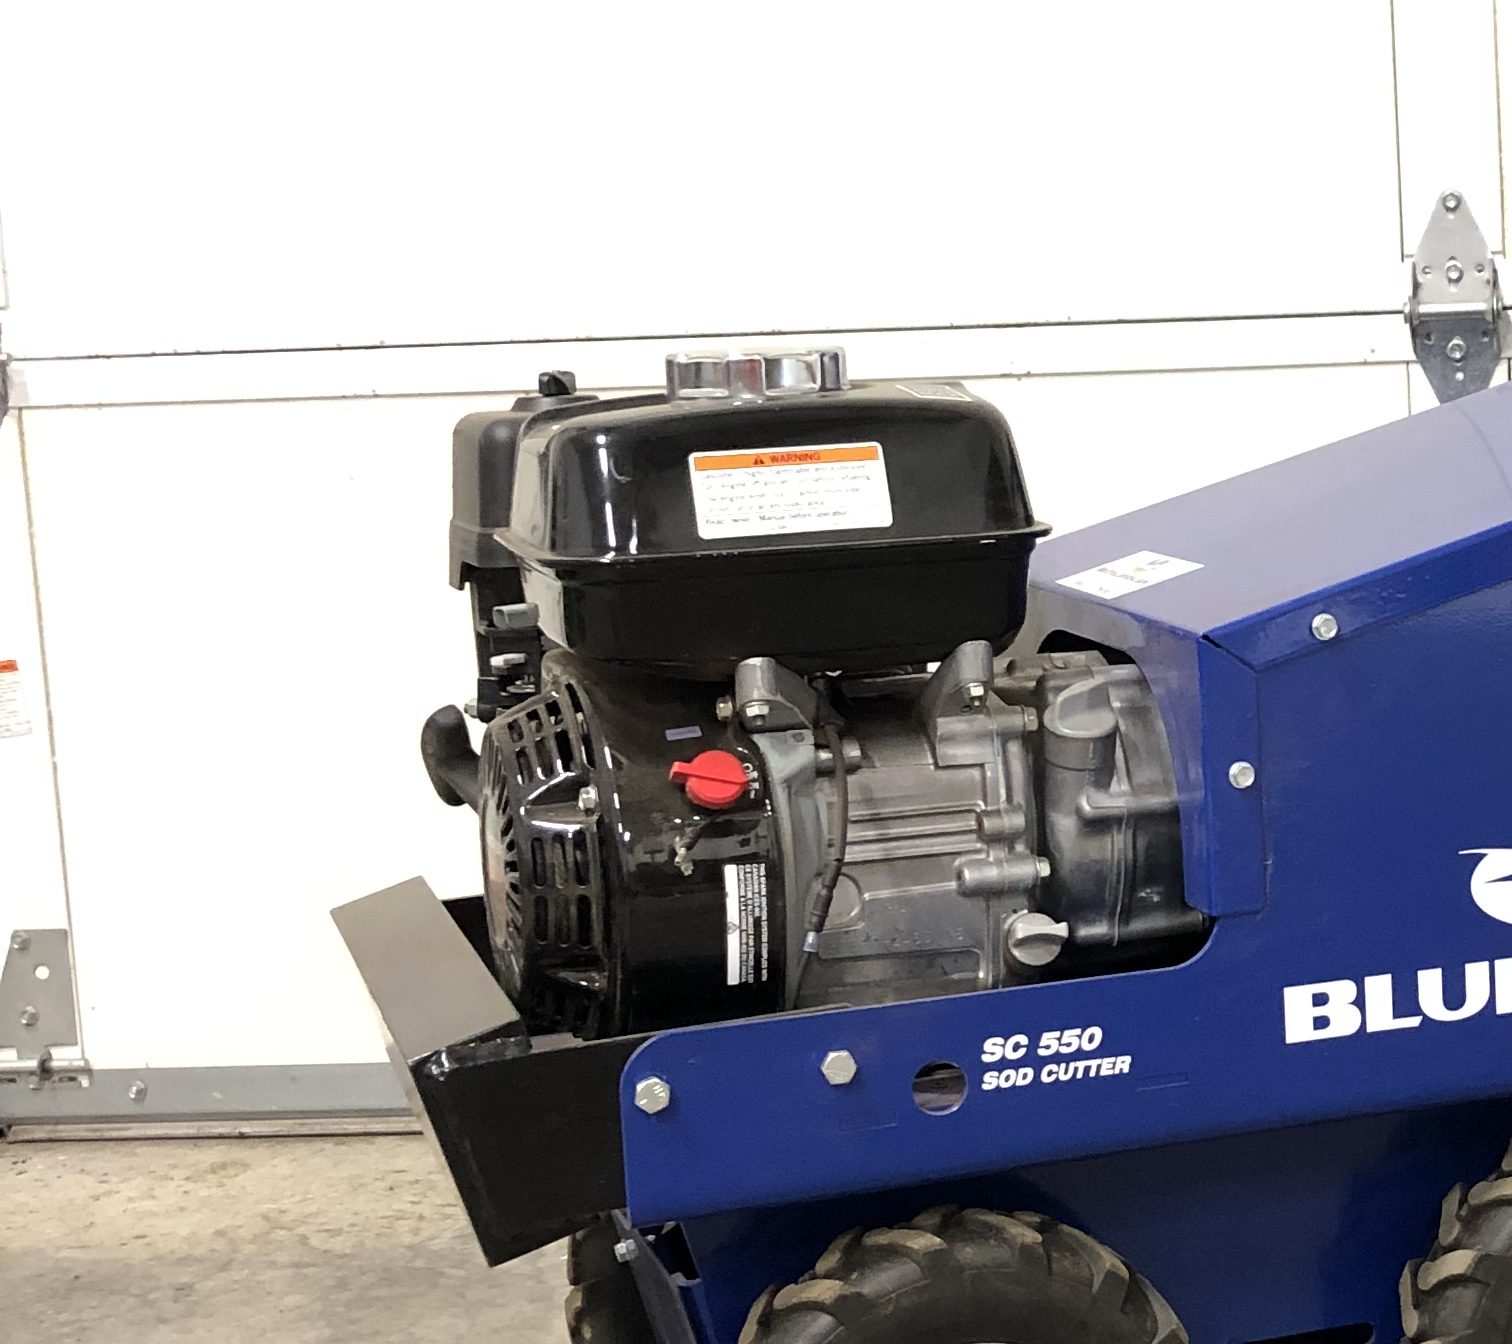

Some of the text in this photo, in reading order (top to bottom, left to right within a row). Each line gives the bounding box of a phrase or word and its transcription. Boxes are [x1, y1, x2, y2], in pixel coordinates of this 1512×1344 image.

[769, 452, 821, 464] WARNING
[981, 1026, 1103, 1063] SC 550
[981, 1055, 1132, 1091] SOD CUTTER
